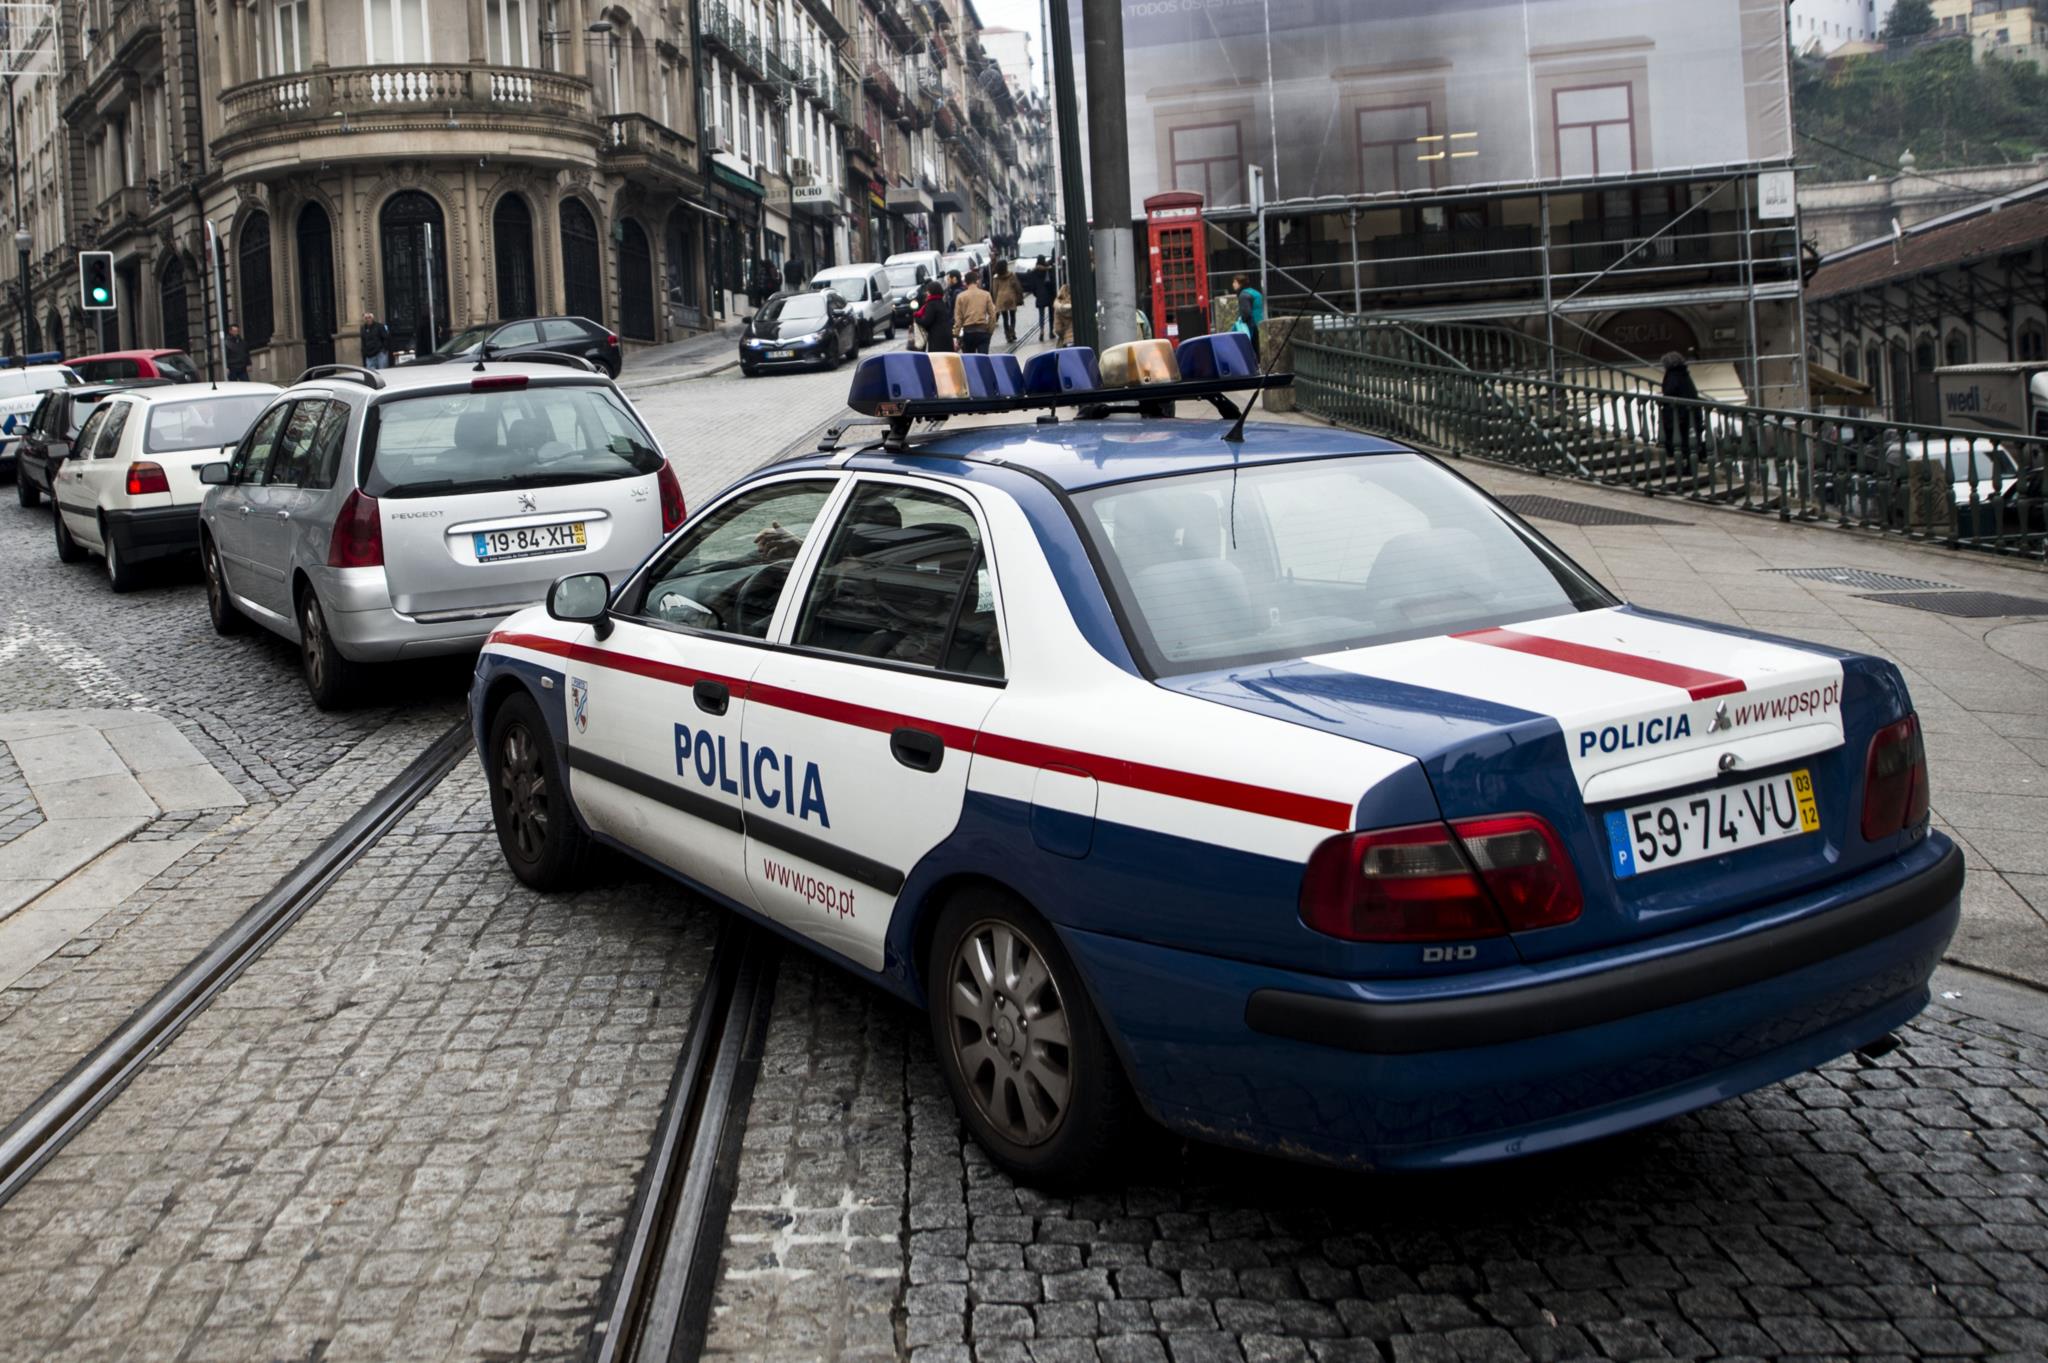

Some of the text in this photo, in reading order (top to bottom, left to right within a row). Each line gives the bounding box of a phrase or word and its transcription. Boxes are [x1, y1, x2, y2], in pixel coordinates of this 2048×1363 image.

[795, 187, 822, 197] OURO
[1614, 322, 1673, 344] SICAL
[1945, 384, 1980, 412] wedi
[391, 510, 445, 520] PEUGEOT
[1580, 713, 1691, 757] POLICIA
[674, 722, 830, 829] POLICIA
[1795, 775, 1810, 793] 03
[1802, 808, 1817, 825] 12
[1618, 850, 1628, 865] P
[763, 858, 855, 918] www.psp.pt
